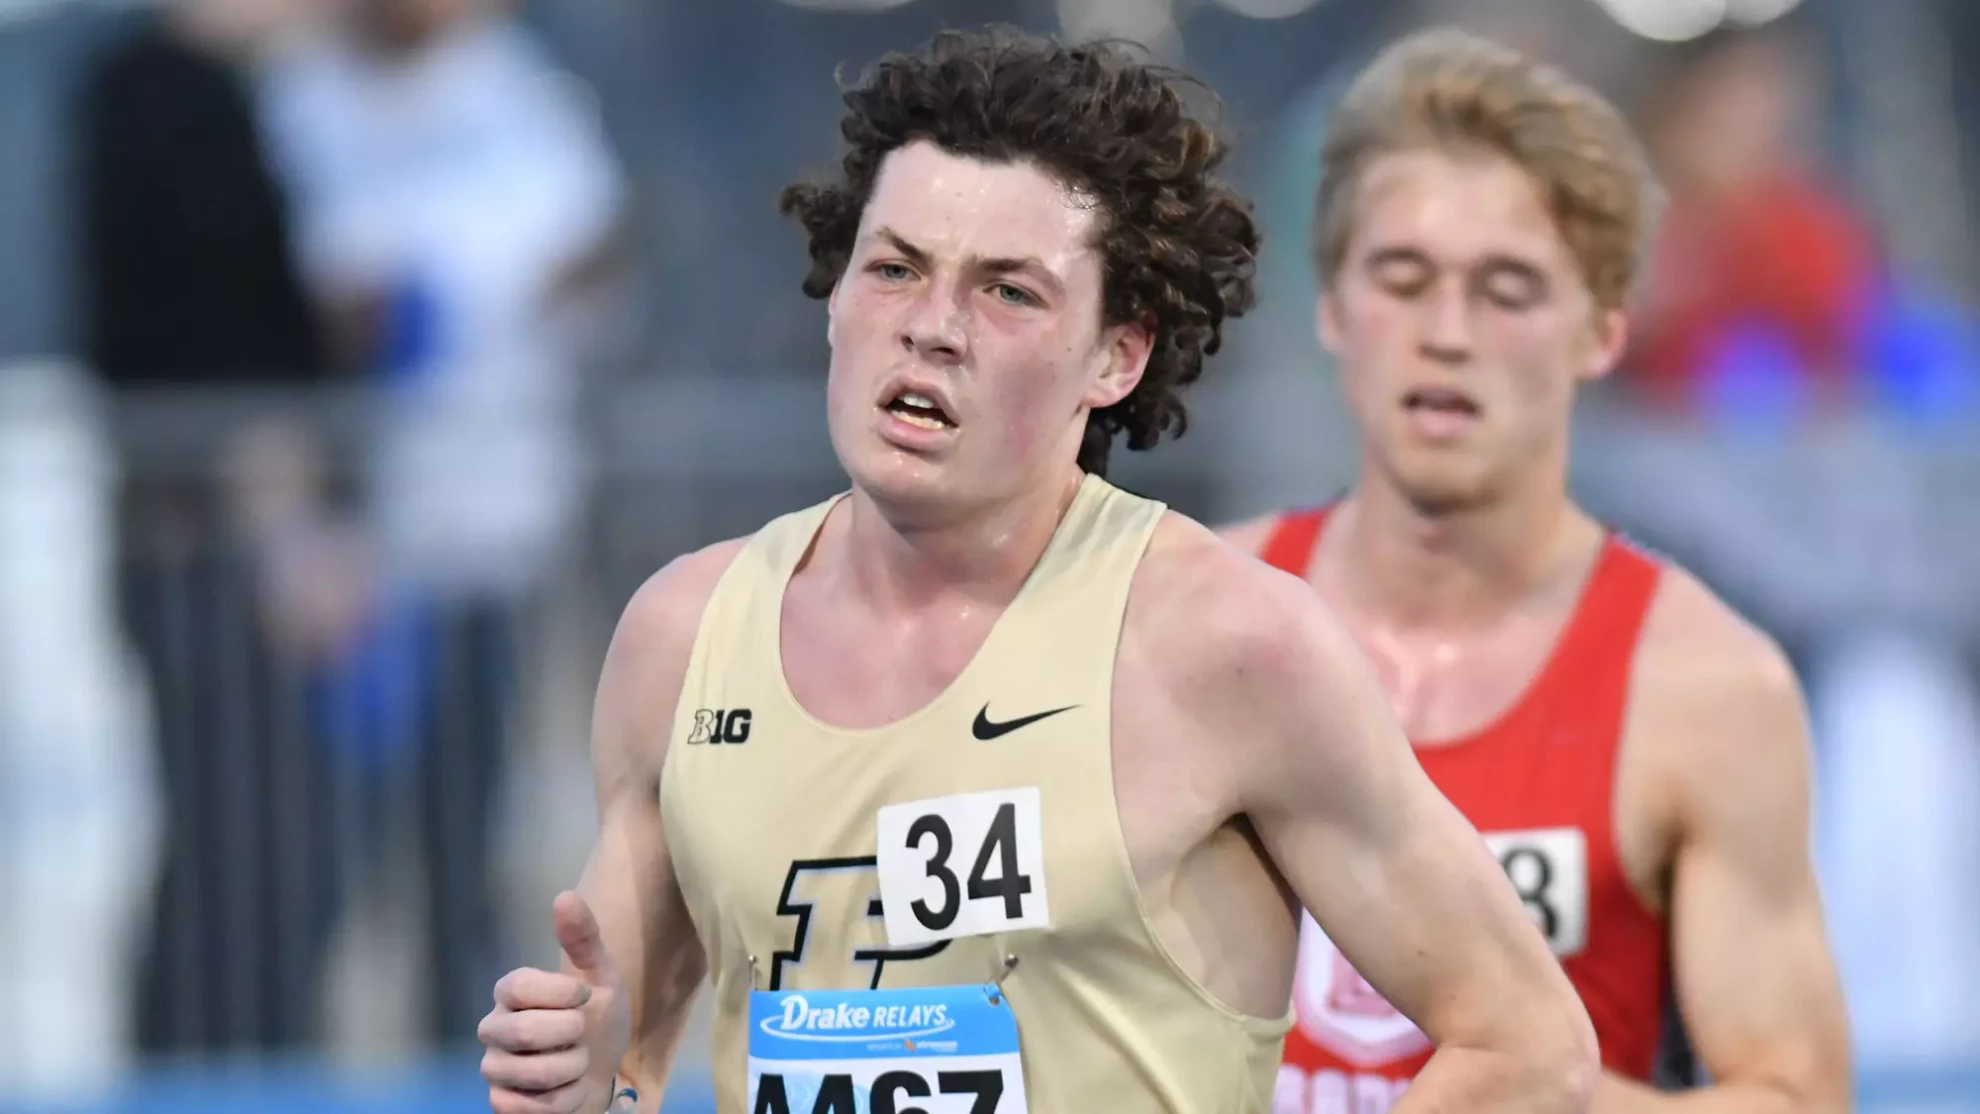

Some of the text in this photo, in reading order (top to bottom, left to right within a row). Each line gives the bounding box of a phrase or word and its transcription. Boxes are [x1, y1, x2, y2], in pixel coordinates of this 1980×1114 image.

[905, 802, 1032, 931] 34
[780, 994, 947, 1031] Drake RELAYS
